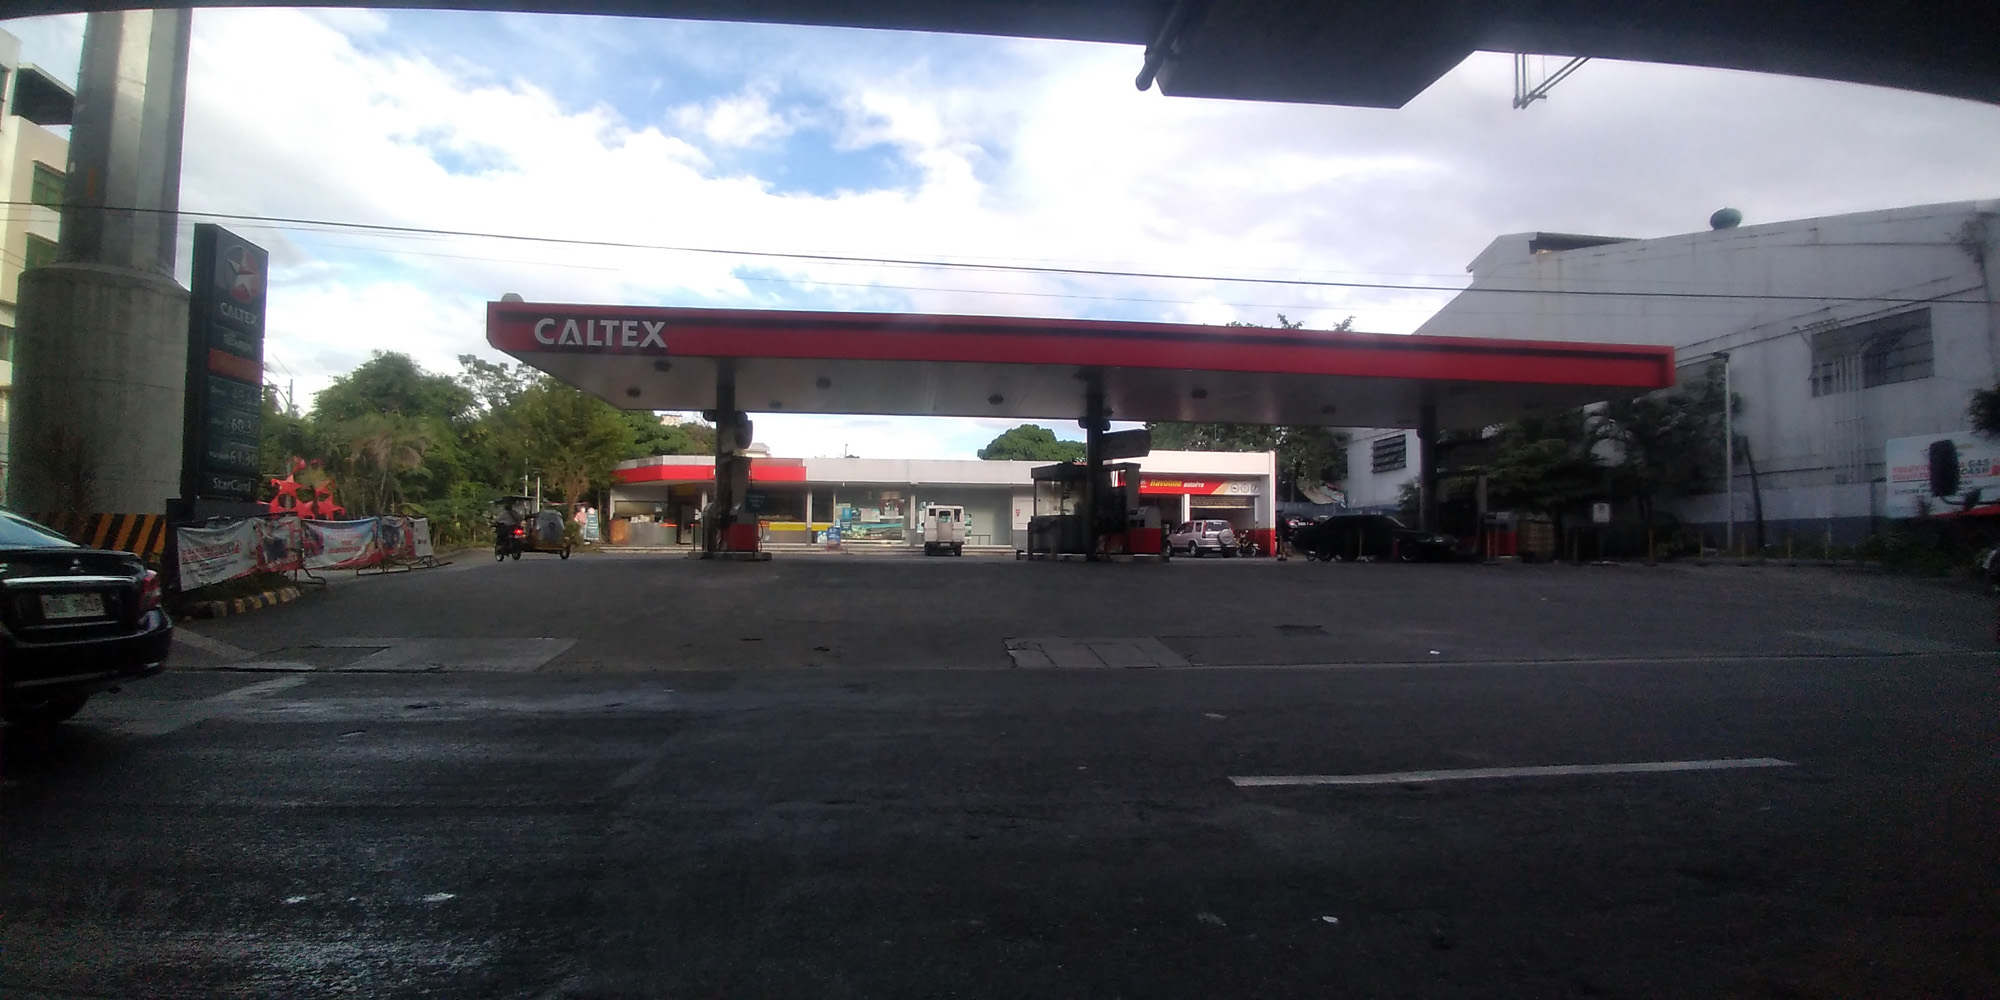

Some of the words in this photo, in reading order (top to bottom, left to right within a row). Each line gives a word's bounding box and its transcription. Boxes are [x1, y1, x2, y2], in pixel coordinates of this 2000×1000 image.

[220, 302, 258, 326] CALTEX
[534, 317, 667, 348] CALTEX
[213, 477, 251, 492] StarCard
